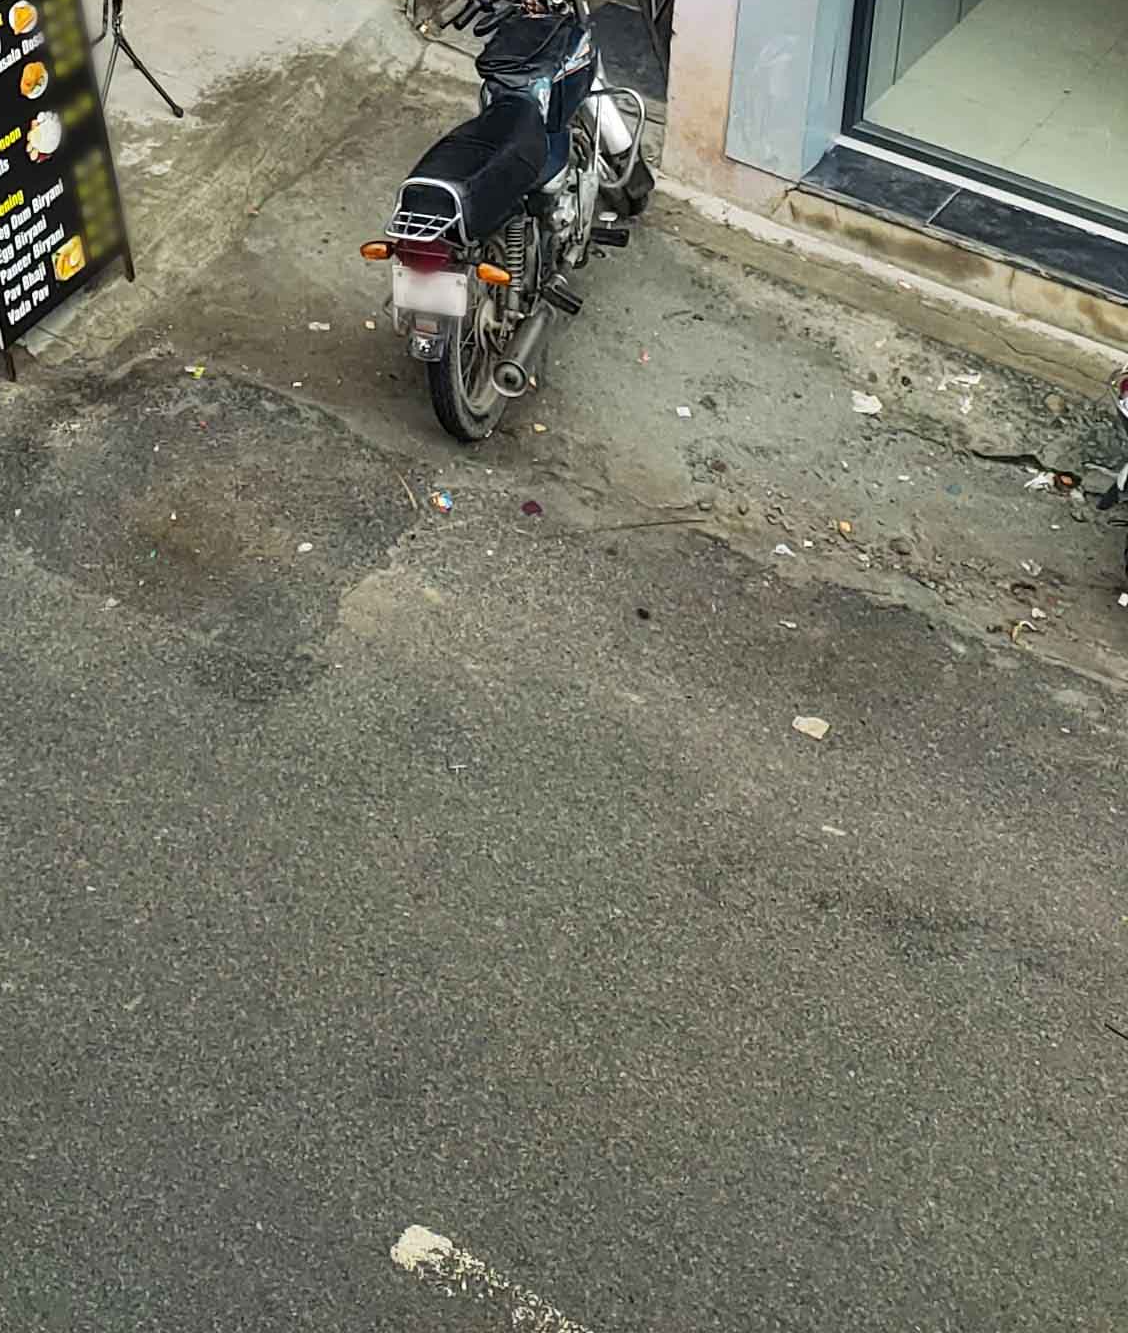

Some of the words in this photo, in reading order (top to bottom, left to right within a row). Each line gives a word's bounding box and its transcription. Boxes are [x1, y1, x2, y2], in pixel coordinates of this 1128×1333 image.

[10, 205, 32, 231] Dum
[31, 177, 65, 214] Biryani
[0, 252, 32, 286] Paneer
[32, 222, 66, 260] Biryani
[14, 213, 48, 251] Biryani
[3, 283, 22, 307] Pav
[21, 261, 47, 292] Bhaji
[7, 300, 33, 326] Vada
[32, 284, 51, 307] Pav
